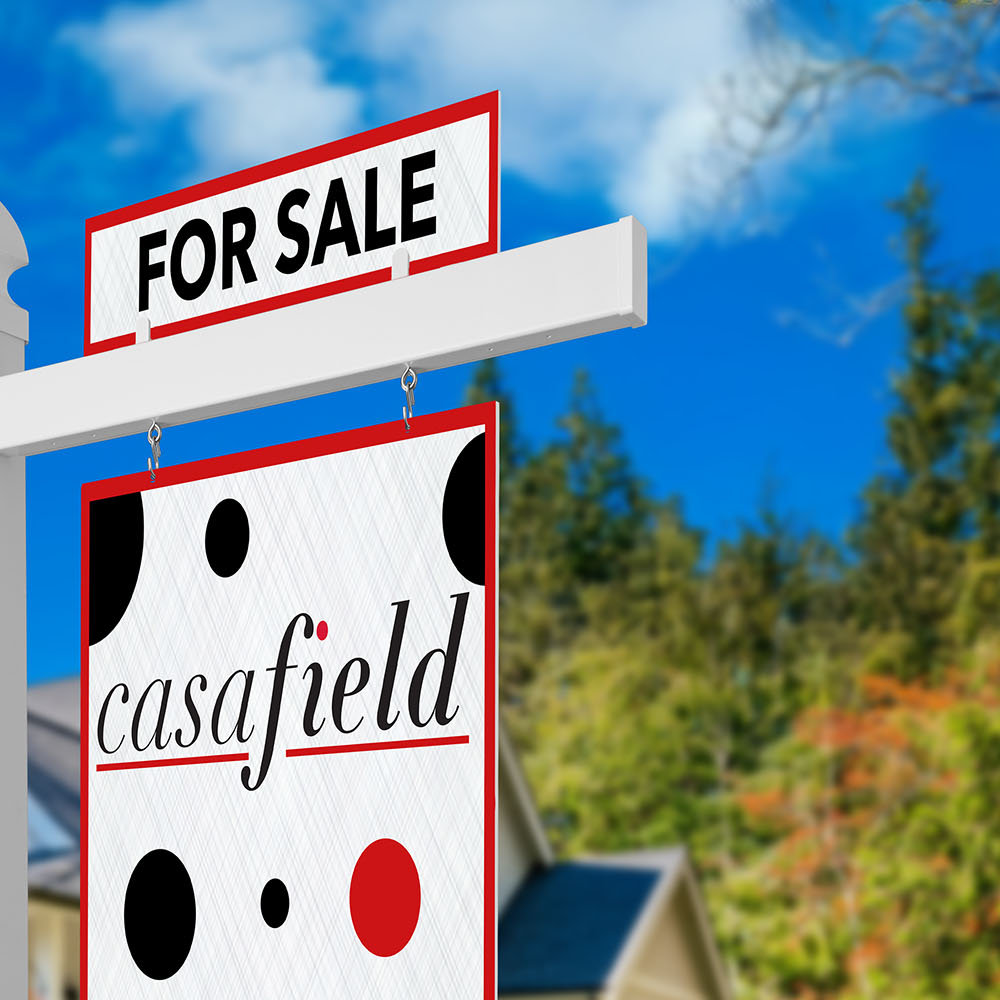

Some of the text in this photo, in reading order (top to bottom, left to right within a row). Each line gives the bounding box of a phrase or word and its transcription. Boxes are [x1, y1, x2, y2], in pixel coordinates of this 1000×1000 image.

[138, 149, 437, 313] FOR SALE
[97, 591, 470, 792] casafield
